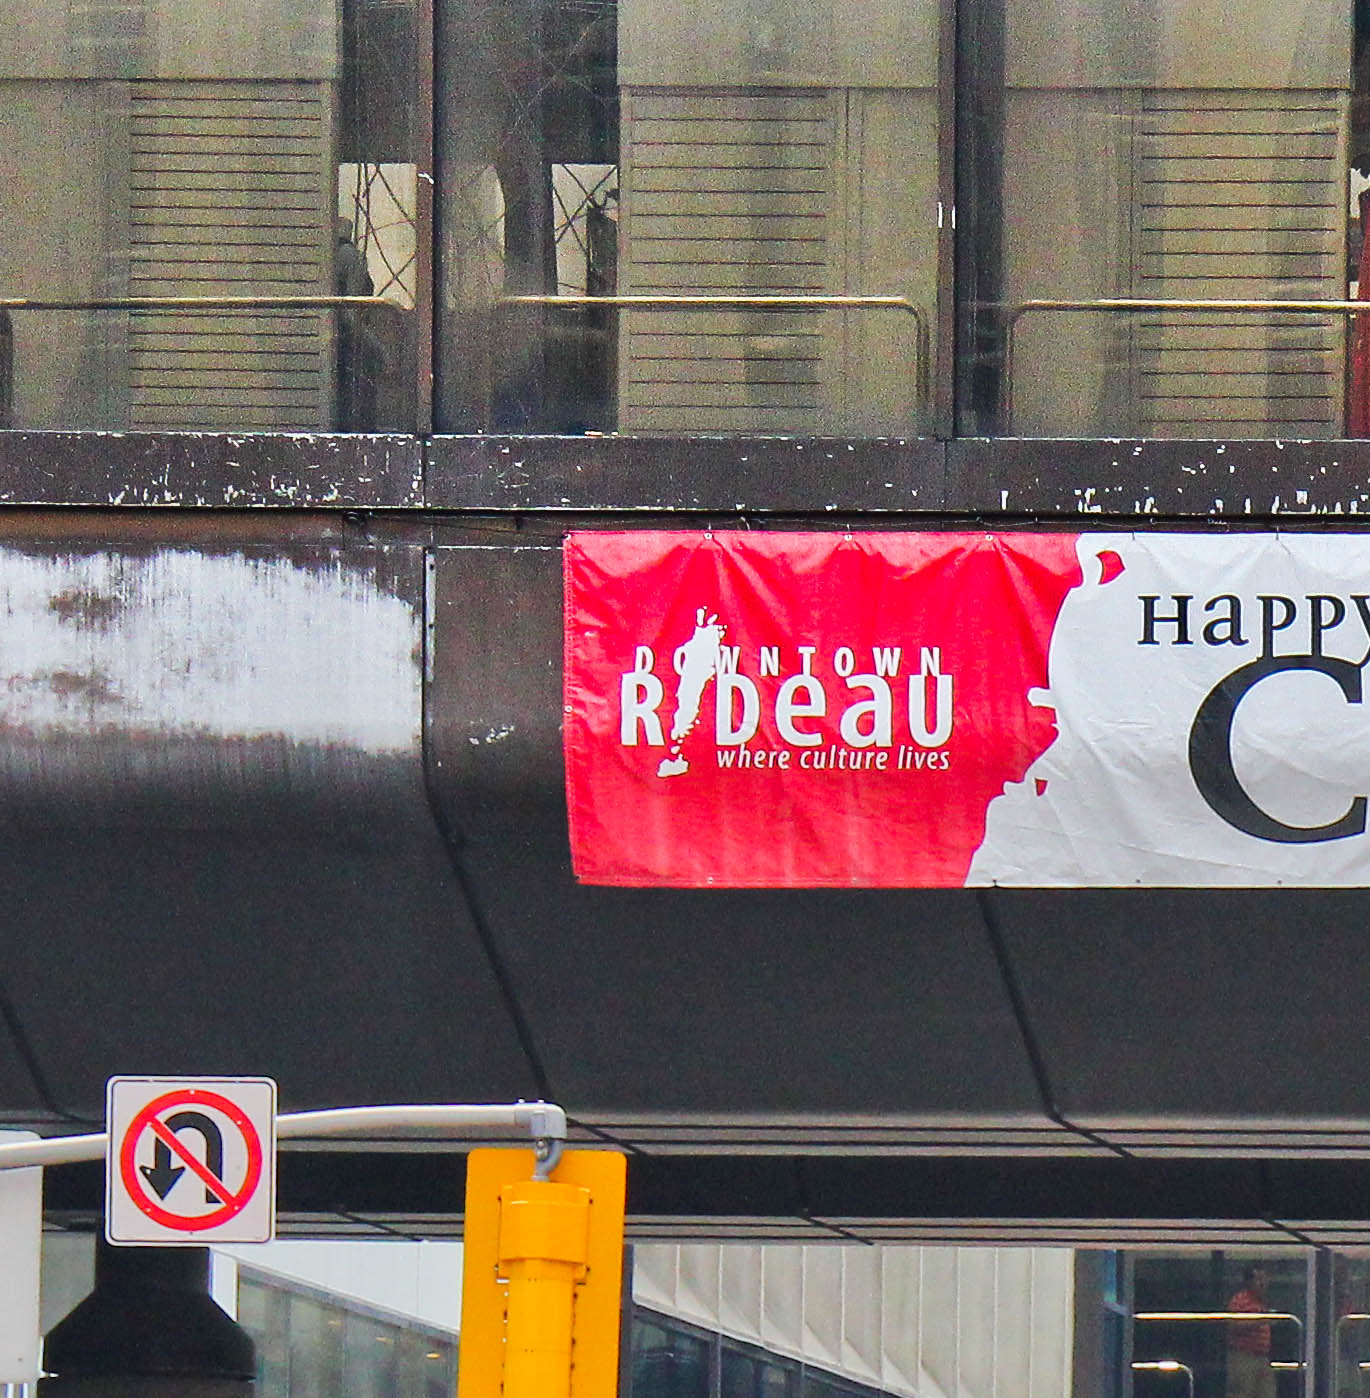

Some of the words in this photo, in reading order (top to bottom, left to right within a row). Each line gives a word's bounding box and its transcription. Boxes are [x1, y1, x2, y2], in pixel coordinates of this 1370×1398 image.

[716, 743, 790, 770] where
[799, 745, 888, 770] culture
[897, 745, 950, 770] lives
